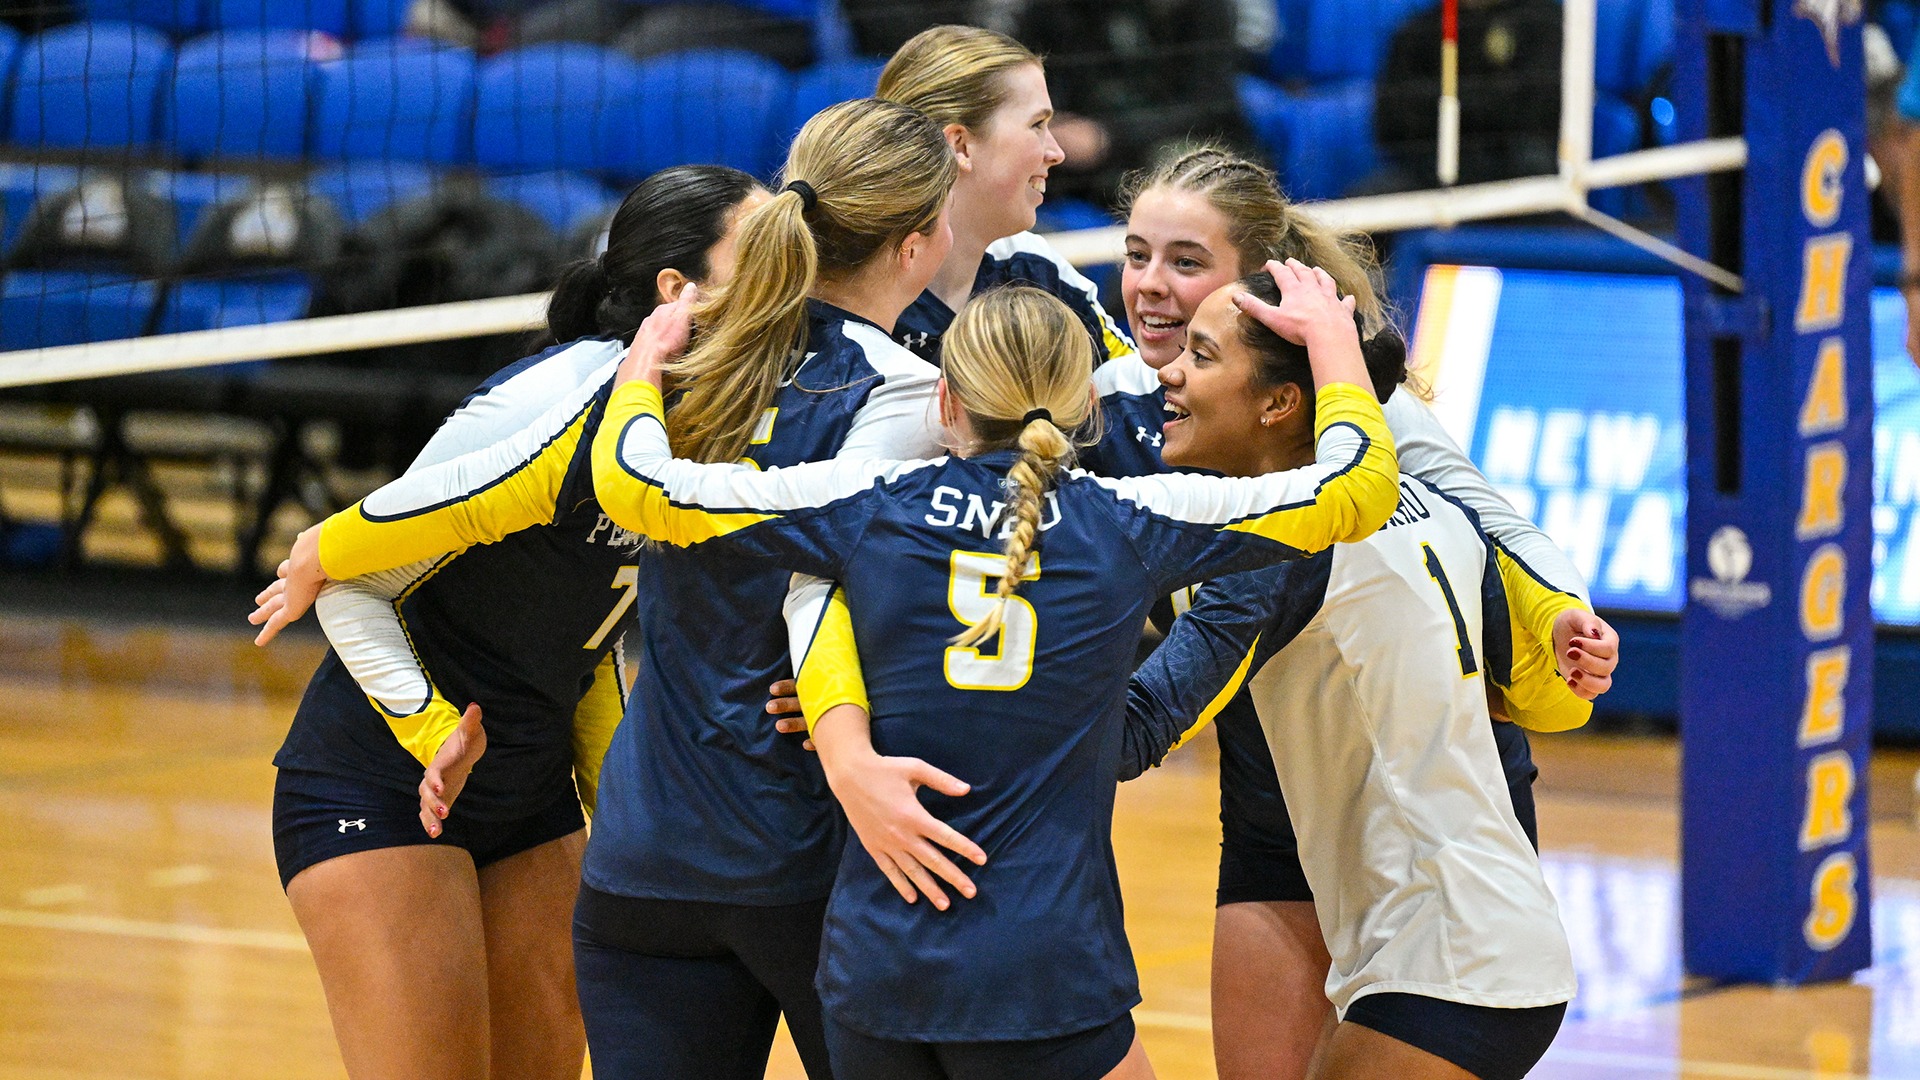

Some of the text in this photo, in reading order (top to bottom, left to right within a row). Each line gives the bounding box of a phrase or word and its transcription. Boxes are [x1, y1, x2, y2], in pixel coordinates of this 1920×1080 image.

[1483, 405, 1660, 491] NEW
[582, 565, 640, 649] 7
[1795, 128, 1861, 952] CHARGERS
[943, 549, 1041, 691] 5
[1419, 541, 1479, 680] 1
